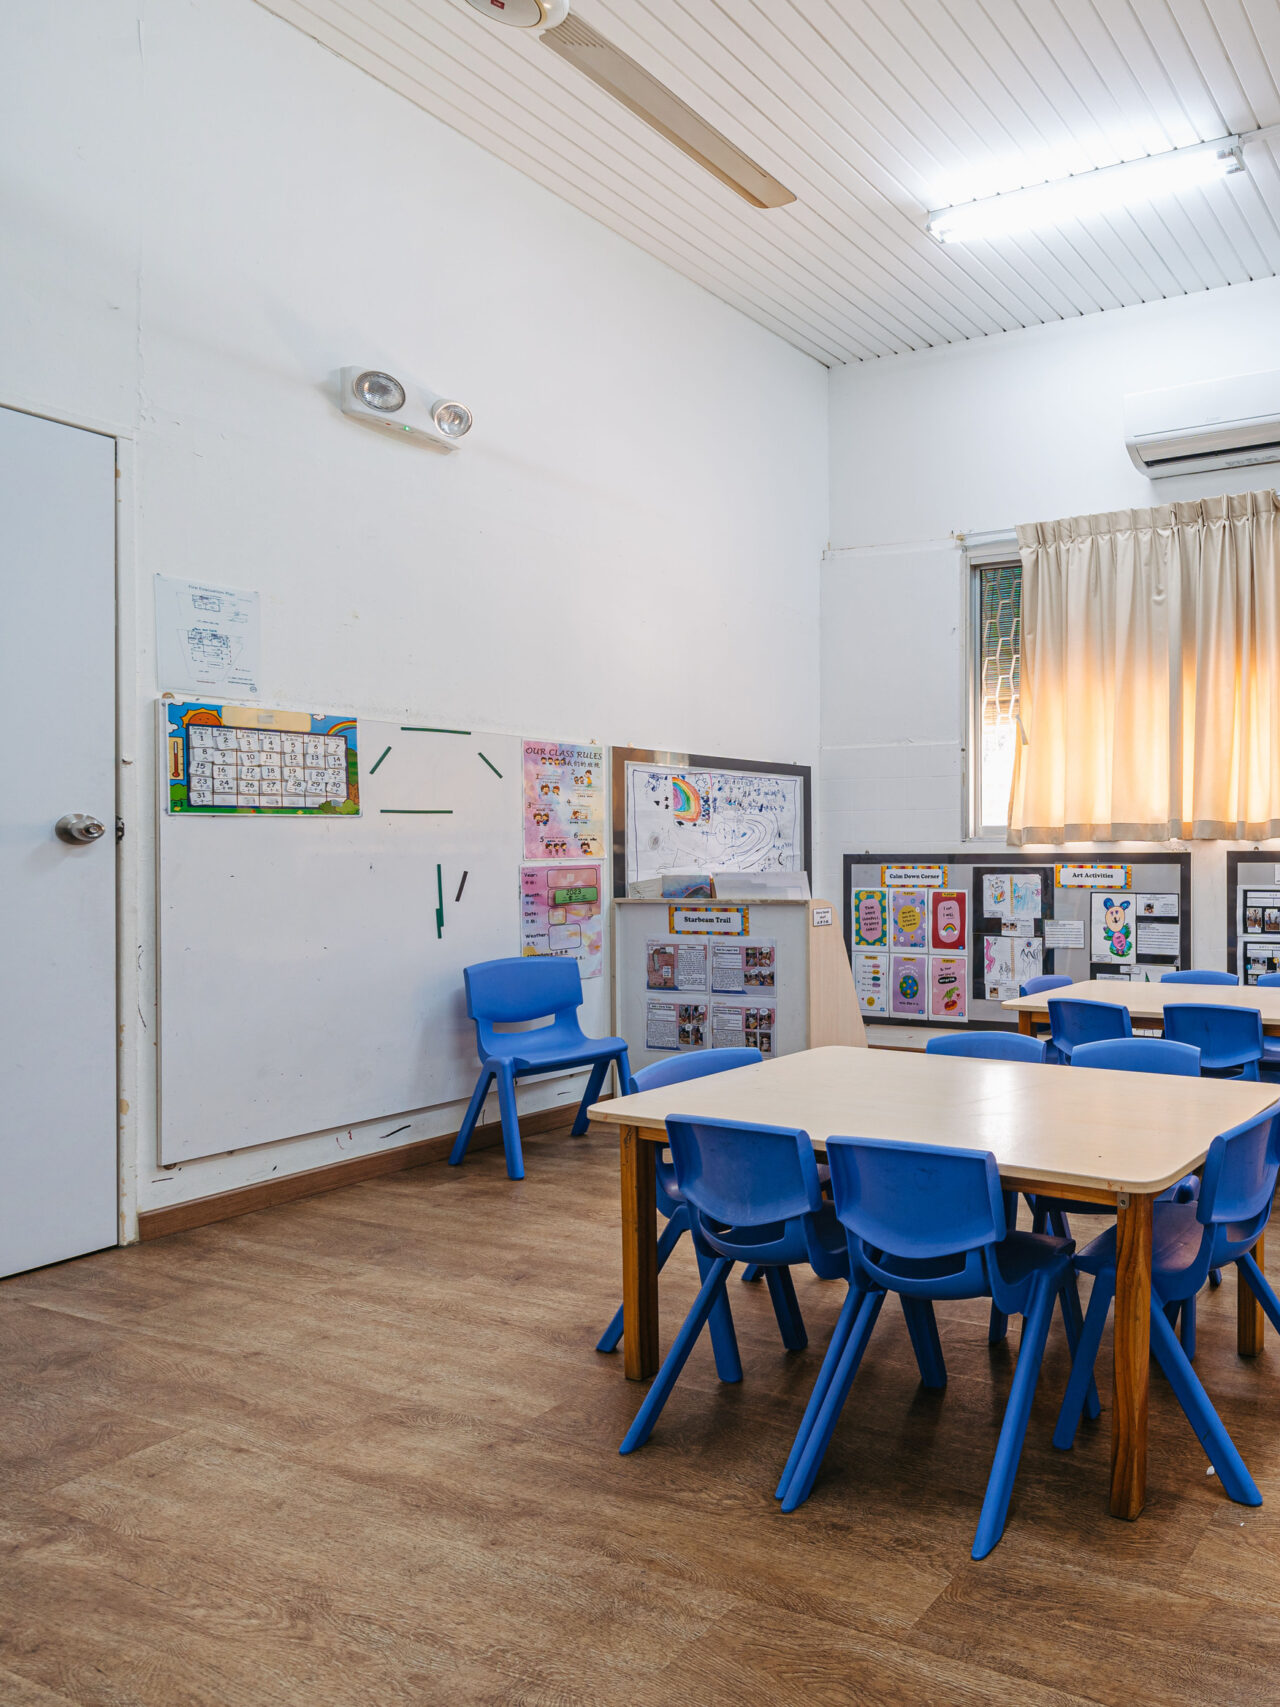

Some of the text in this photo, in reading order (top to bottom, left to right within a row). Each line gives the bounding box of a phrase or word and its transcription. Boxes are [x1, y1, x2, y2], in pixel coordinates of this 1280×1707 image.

[223, 736, 229, 744] 2
[202, 748, 208, 756] 8
[220, 751, 226, 759] 9
[525, 746, 603, 760] OUR CLASS RULES
[311, 753, 320, 761] 13
[196, 762, 206, 770] 15
[219, 779, 230, 787] 24
[196, 791, 206, 799] 31
